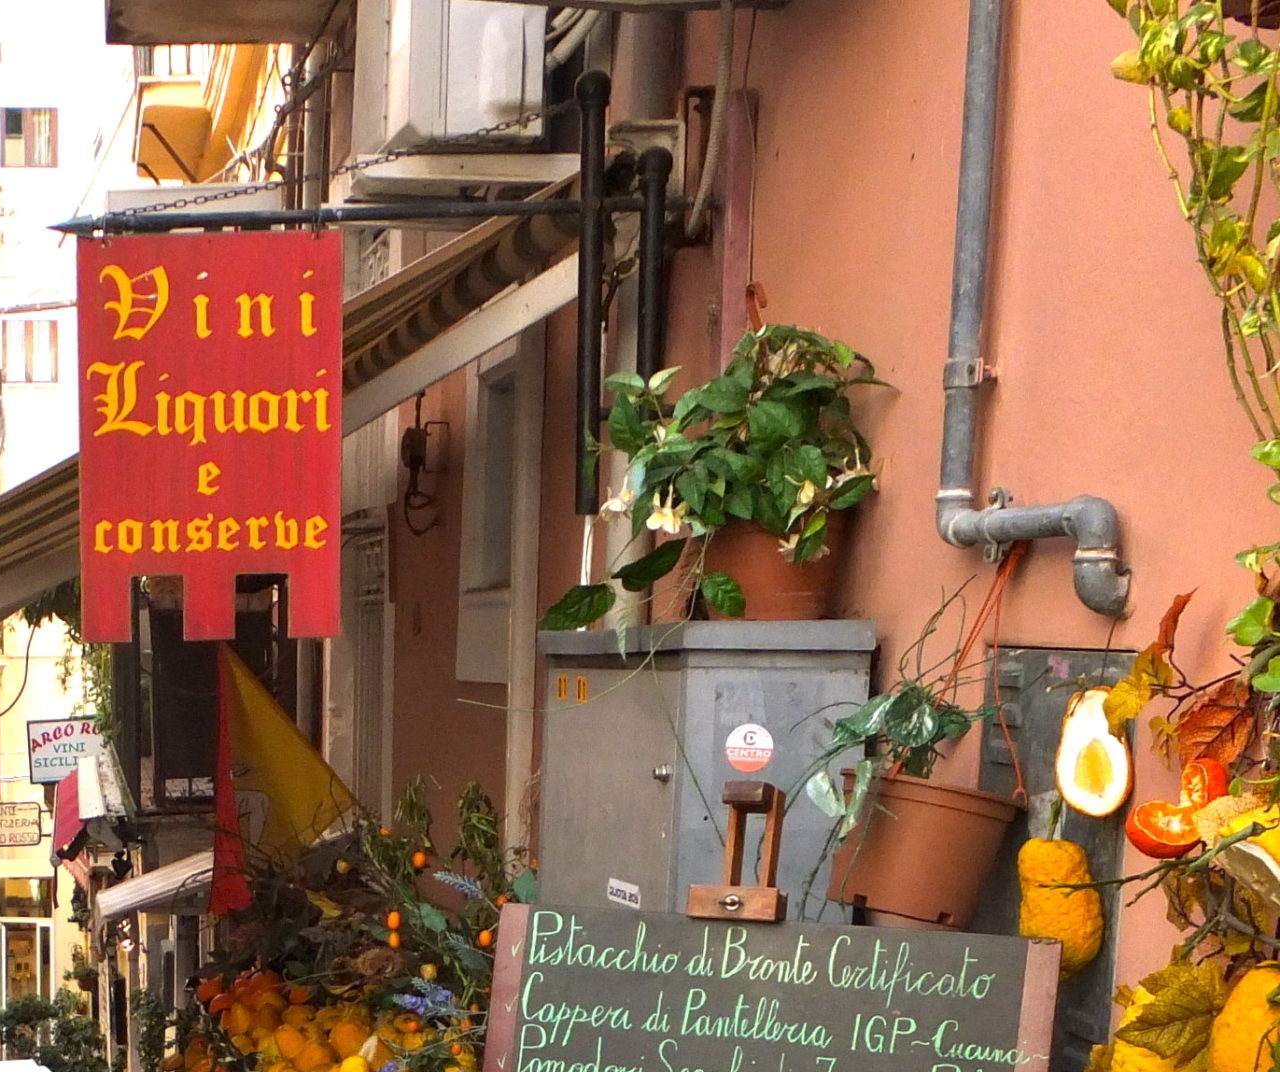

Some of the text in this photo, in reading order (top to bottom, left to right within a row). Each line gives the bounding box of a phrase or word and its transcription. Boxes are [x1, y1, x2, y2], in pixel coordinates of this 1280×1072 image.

[99, 264, 317, 340] Vini
[87, 360, 331, 446] Liquori
[197, 461, 221, 495] e
[94, 511, 328, 553] conserve
[31, 723, 74, 752] ARCO
[53, 743, 85, 753] VINI
[9, 832, 40, 843] ROSSO
[528, 910, 996, 1008] Pistacchio di Bronte Certificato
[522, 971, 632, 1046] Capperi
[641, 991, 670, 1033] di
[681, 987, 833, 1049] Pantelleria
[851, 1013, 917, 1054] IGP
